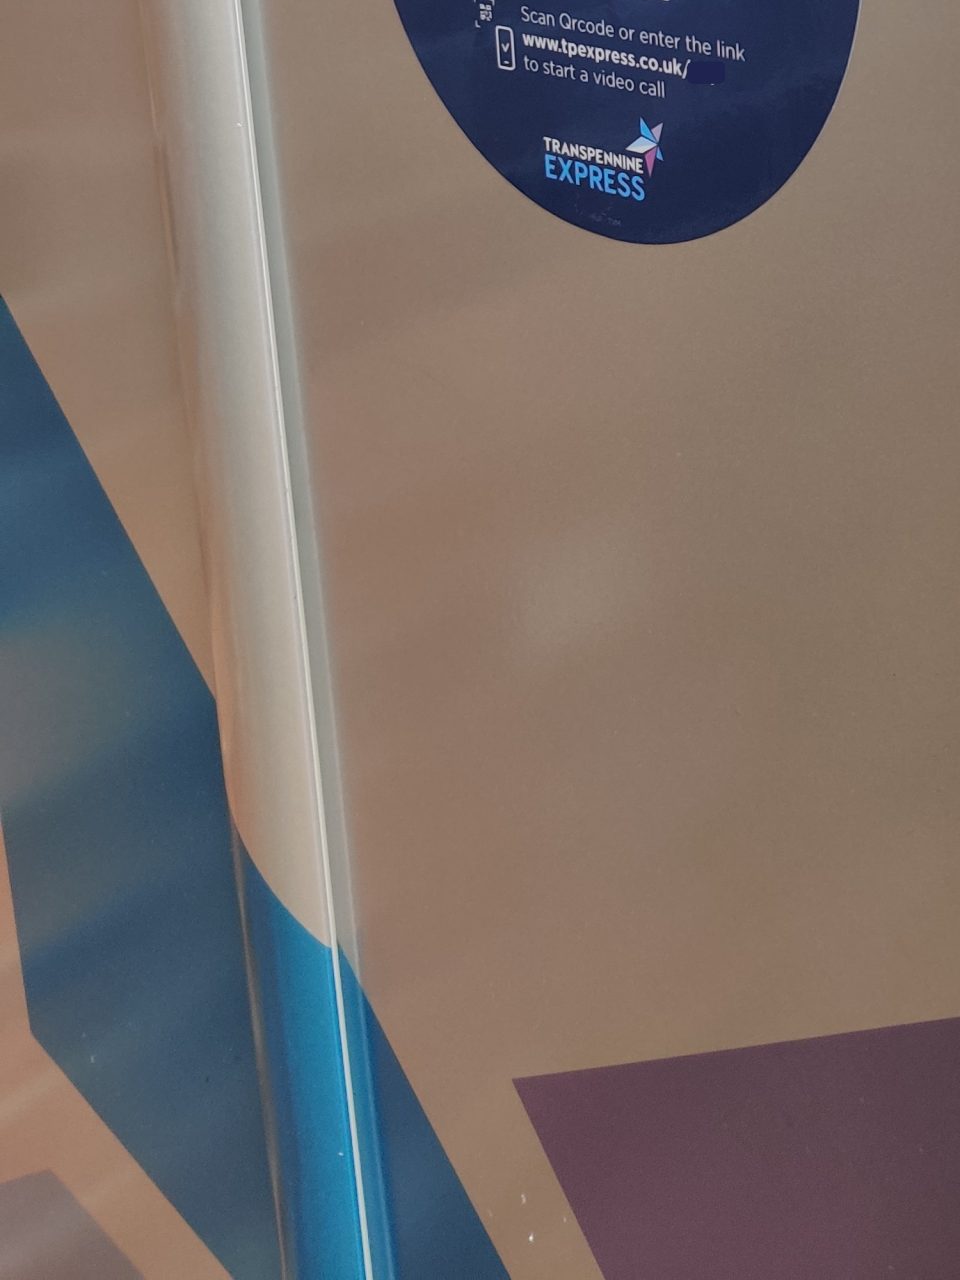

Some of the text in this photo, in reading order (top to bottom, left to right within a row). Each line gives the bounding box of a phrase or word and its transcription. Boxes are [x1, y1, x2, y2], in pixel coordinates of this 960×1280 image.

[520, 5, 746, 62] Scan Qrcode or enter the link
[523, 55, 666, 99] to start a video call
[543, 136, 645, 174] TRANSPENNINE
[544, 153, 646, 201] EXPRESS
